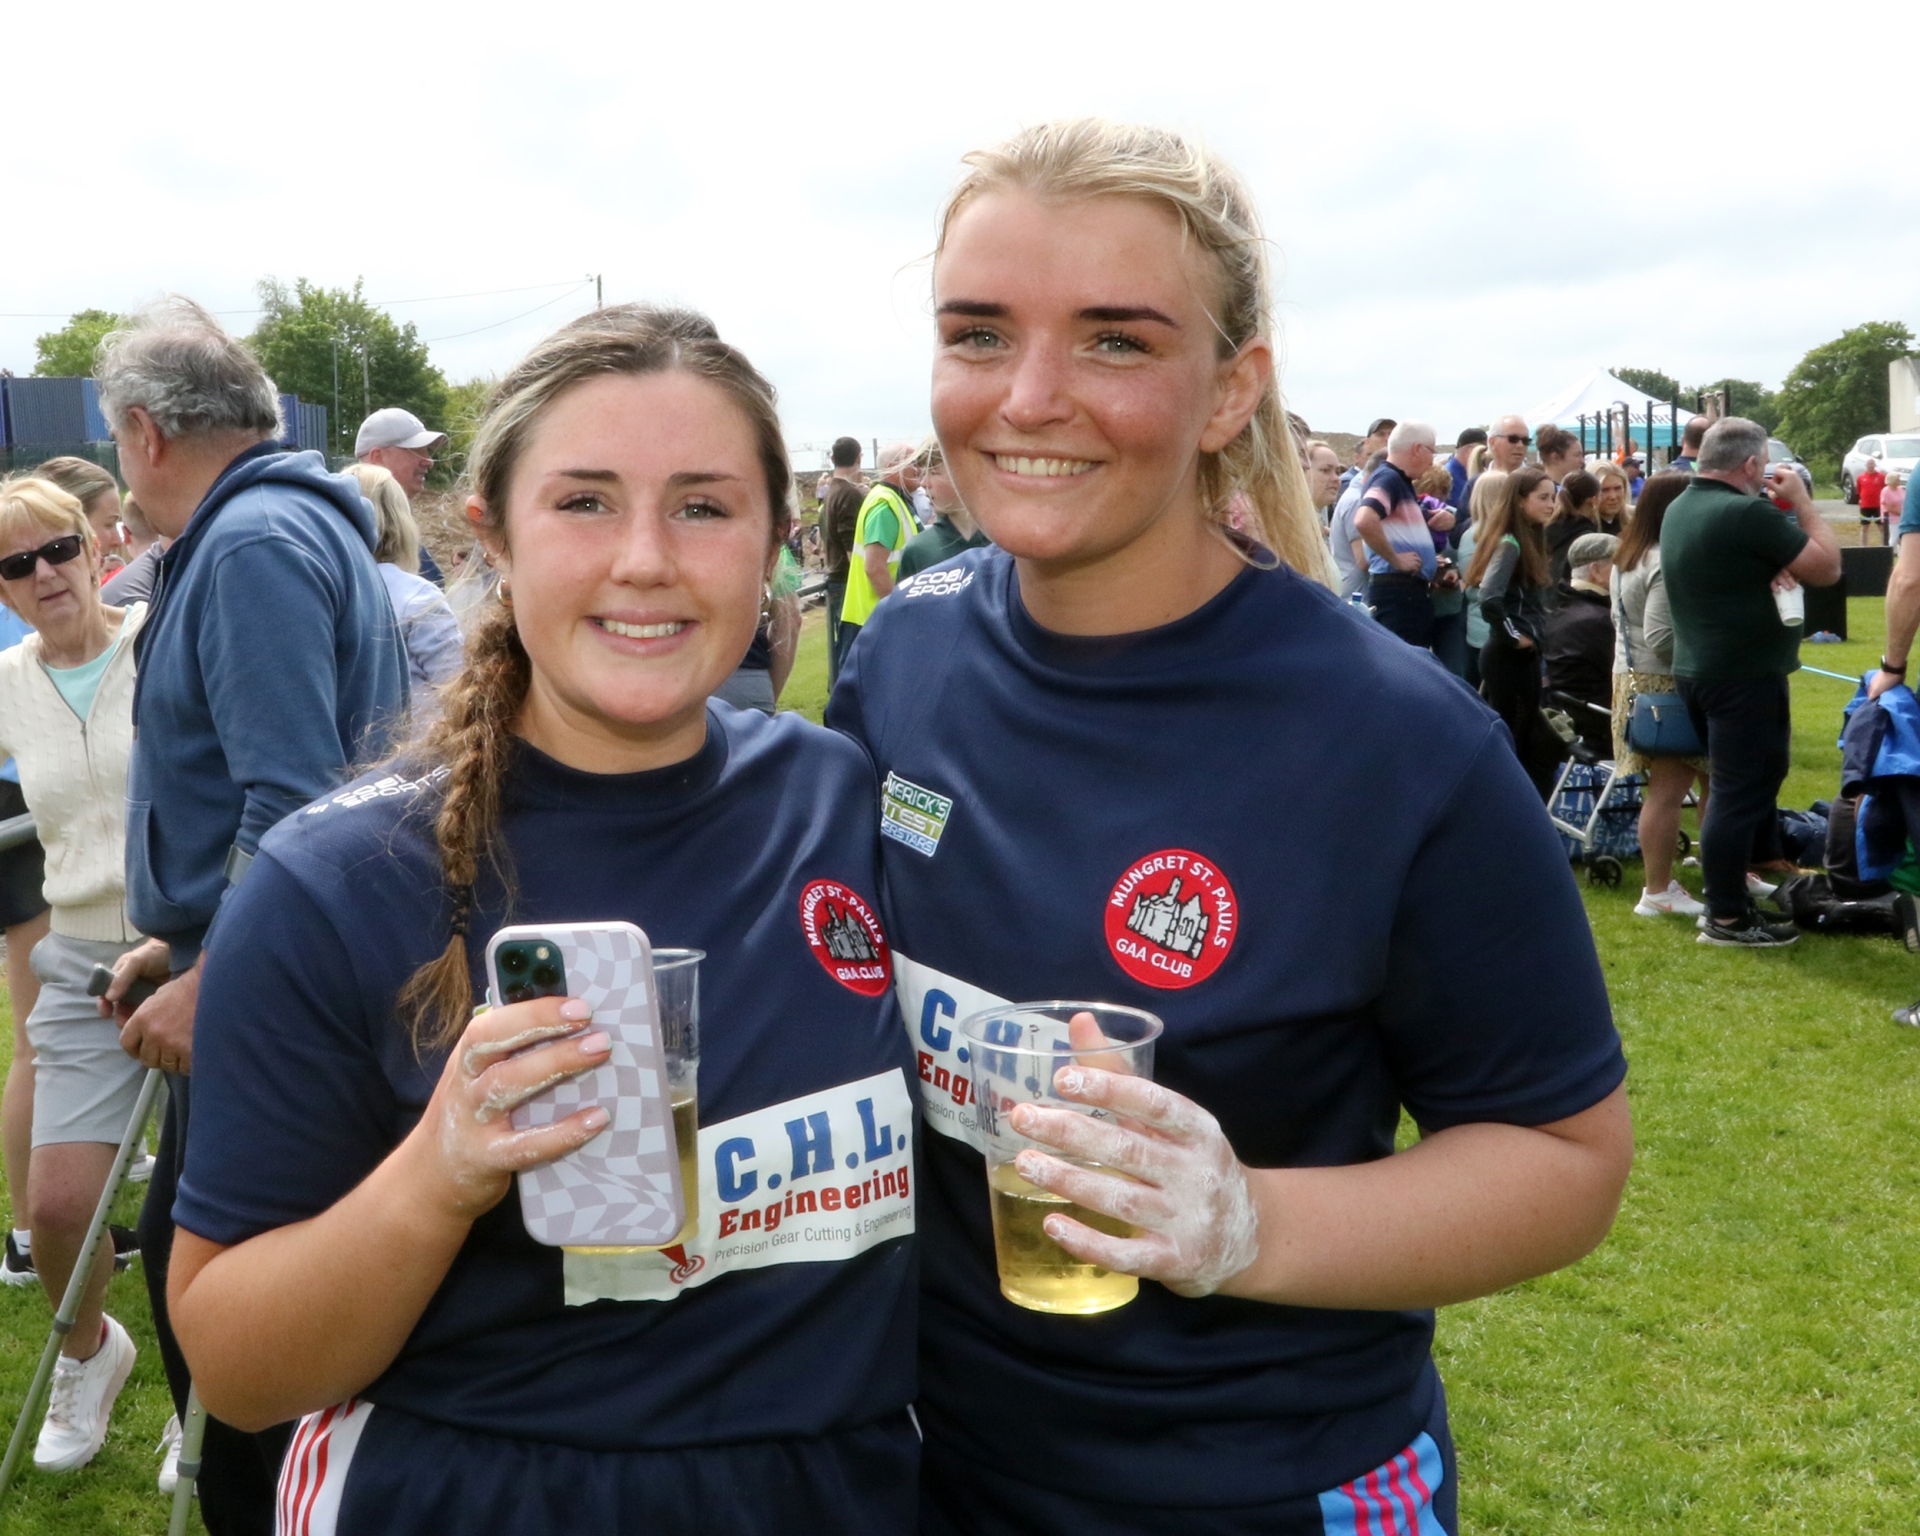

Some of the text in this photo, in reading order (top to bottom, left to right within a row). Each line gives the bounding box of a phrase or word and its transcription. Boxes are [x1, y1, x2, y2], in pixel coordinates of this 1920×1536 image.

[803, 885, 825, 946] MUNGRET
[849, 896, 884, 944] PAULS
[1111, 856, 1233, 948] MUNGRET ST. PAULS
[1115, 938, 1193, 978] GAA CLUB
[714, 1097, 906, 1203] C.H.L.
[714, 1204, 911, 1262] Precision Gear Cutting & Engineering
[718, 1165, 909, 1239] Engineering
